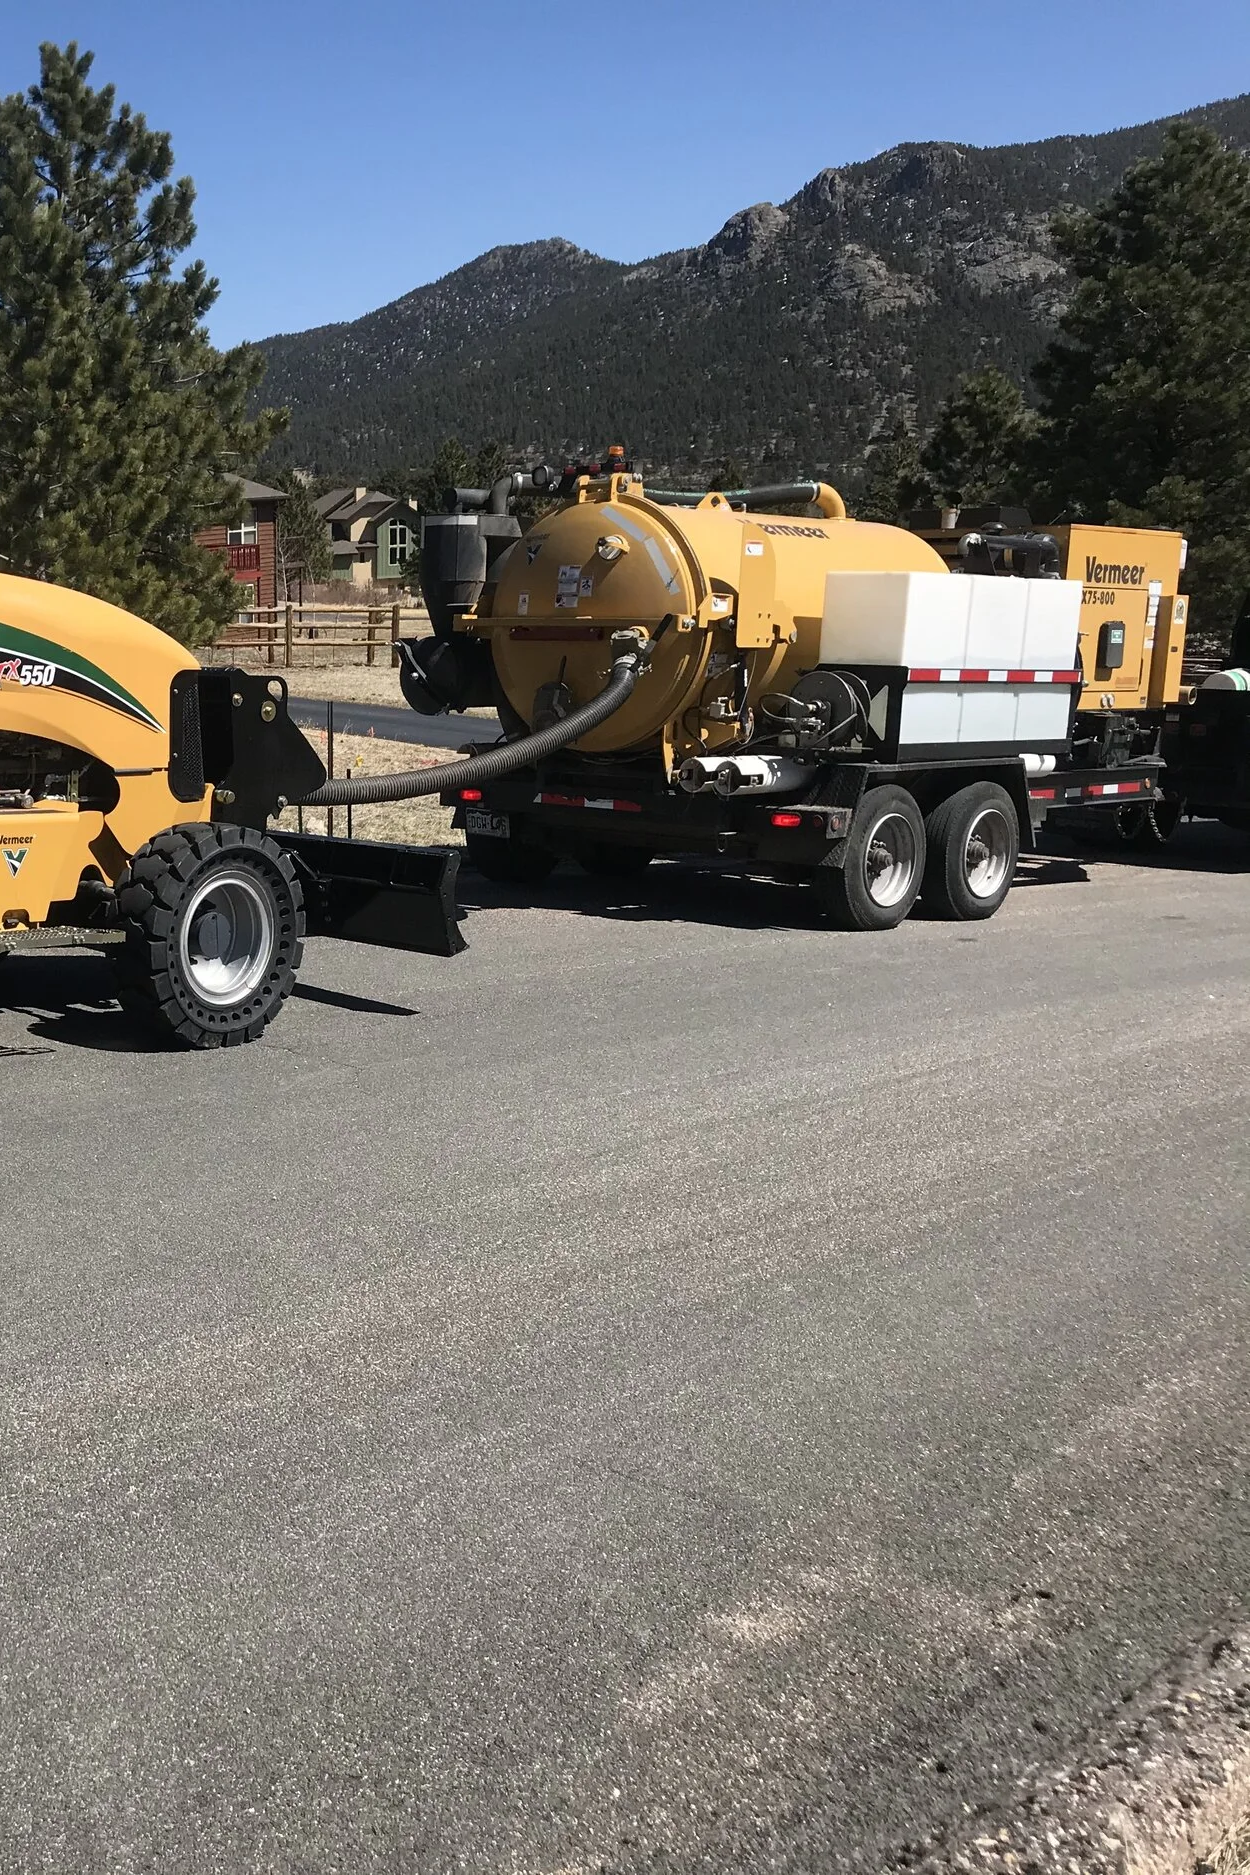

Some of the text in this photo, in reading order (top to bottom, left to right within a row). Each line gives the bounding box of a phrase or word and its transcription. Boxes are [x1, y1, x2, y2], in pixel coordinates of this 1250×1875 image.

[1086, 556, 1145, 585] Vermeer
[1081, 590, 1115, 605] X75-800
[20, 665, 56, 686] 550
